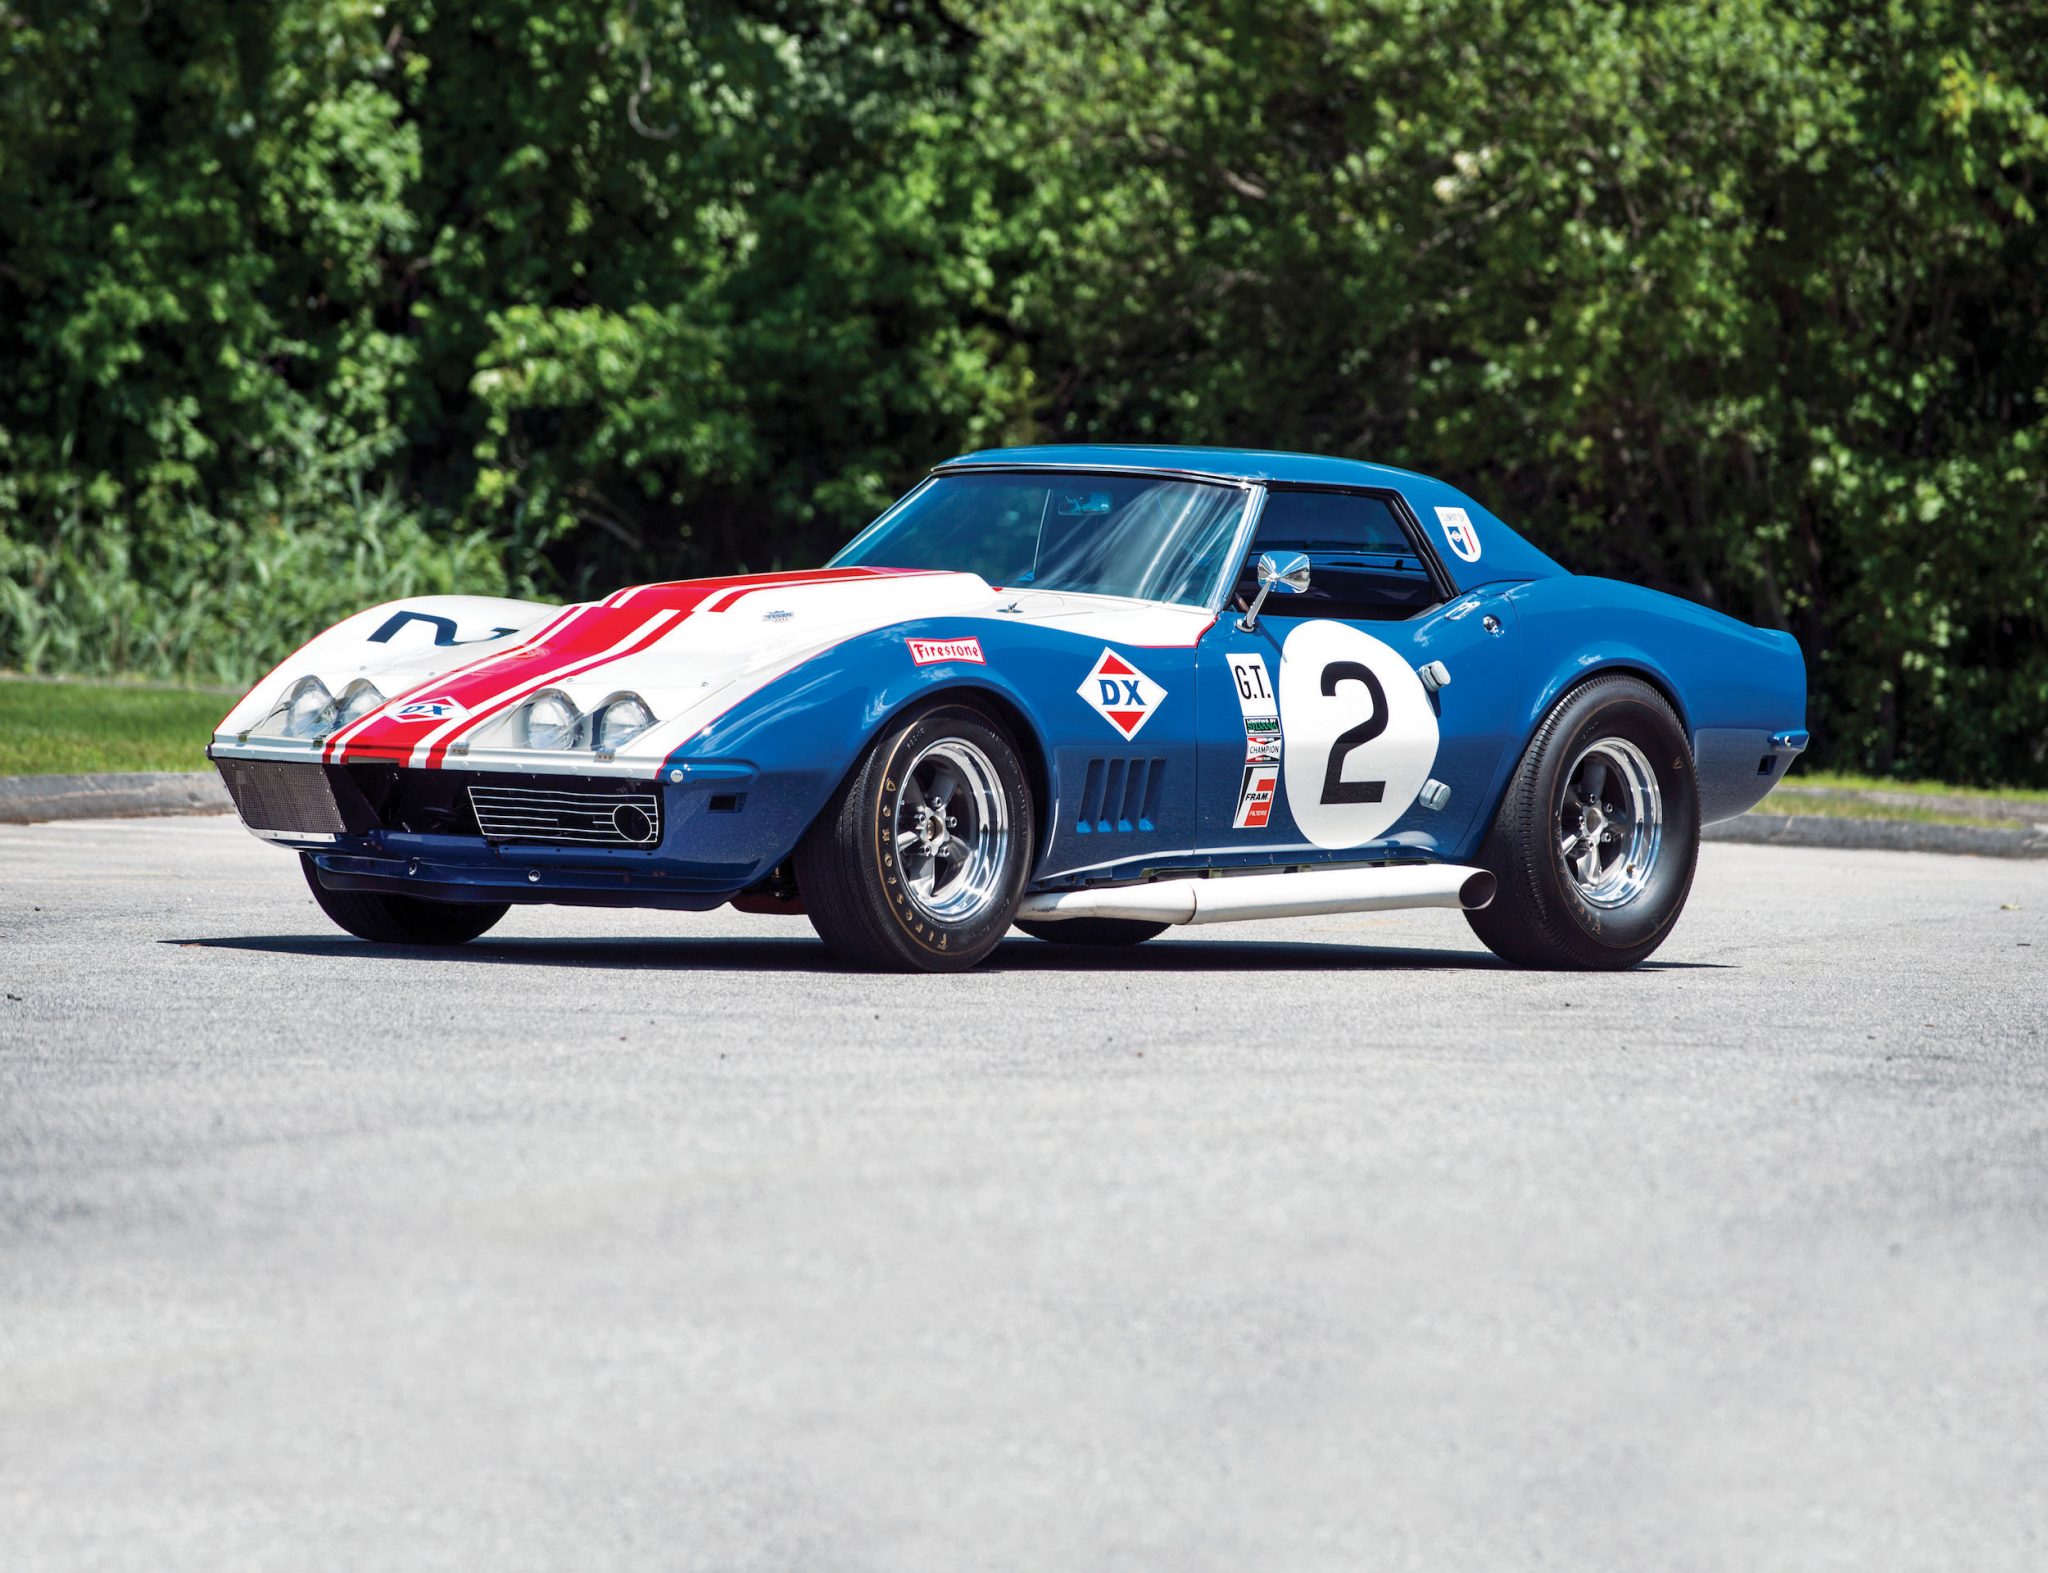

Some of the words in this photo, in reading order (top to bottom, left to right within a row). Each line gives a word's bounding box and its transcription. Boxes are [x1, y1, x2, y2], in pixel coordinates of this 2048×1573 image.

[366, 610, 520, 646] 2
[913, 643, 979, 659] Firestone
[1097, 679, 1148, 706] DX
[1234, 665, 1272, 700] G.T.
[399, 705, 453, 716] DX
[1319, 660, 1389, 805] 2
[1249, 745, 1279, 754] CHAMPION
[1245, 792, 1269, 801] FRAM
